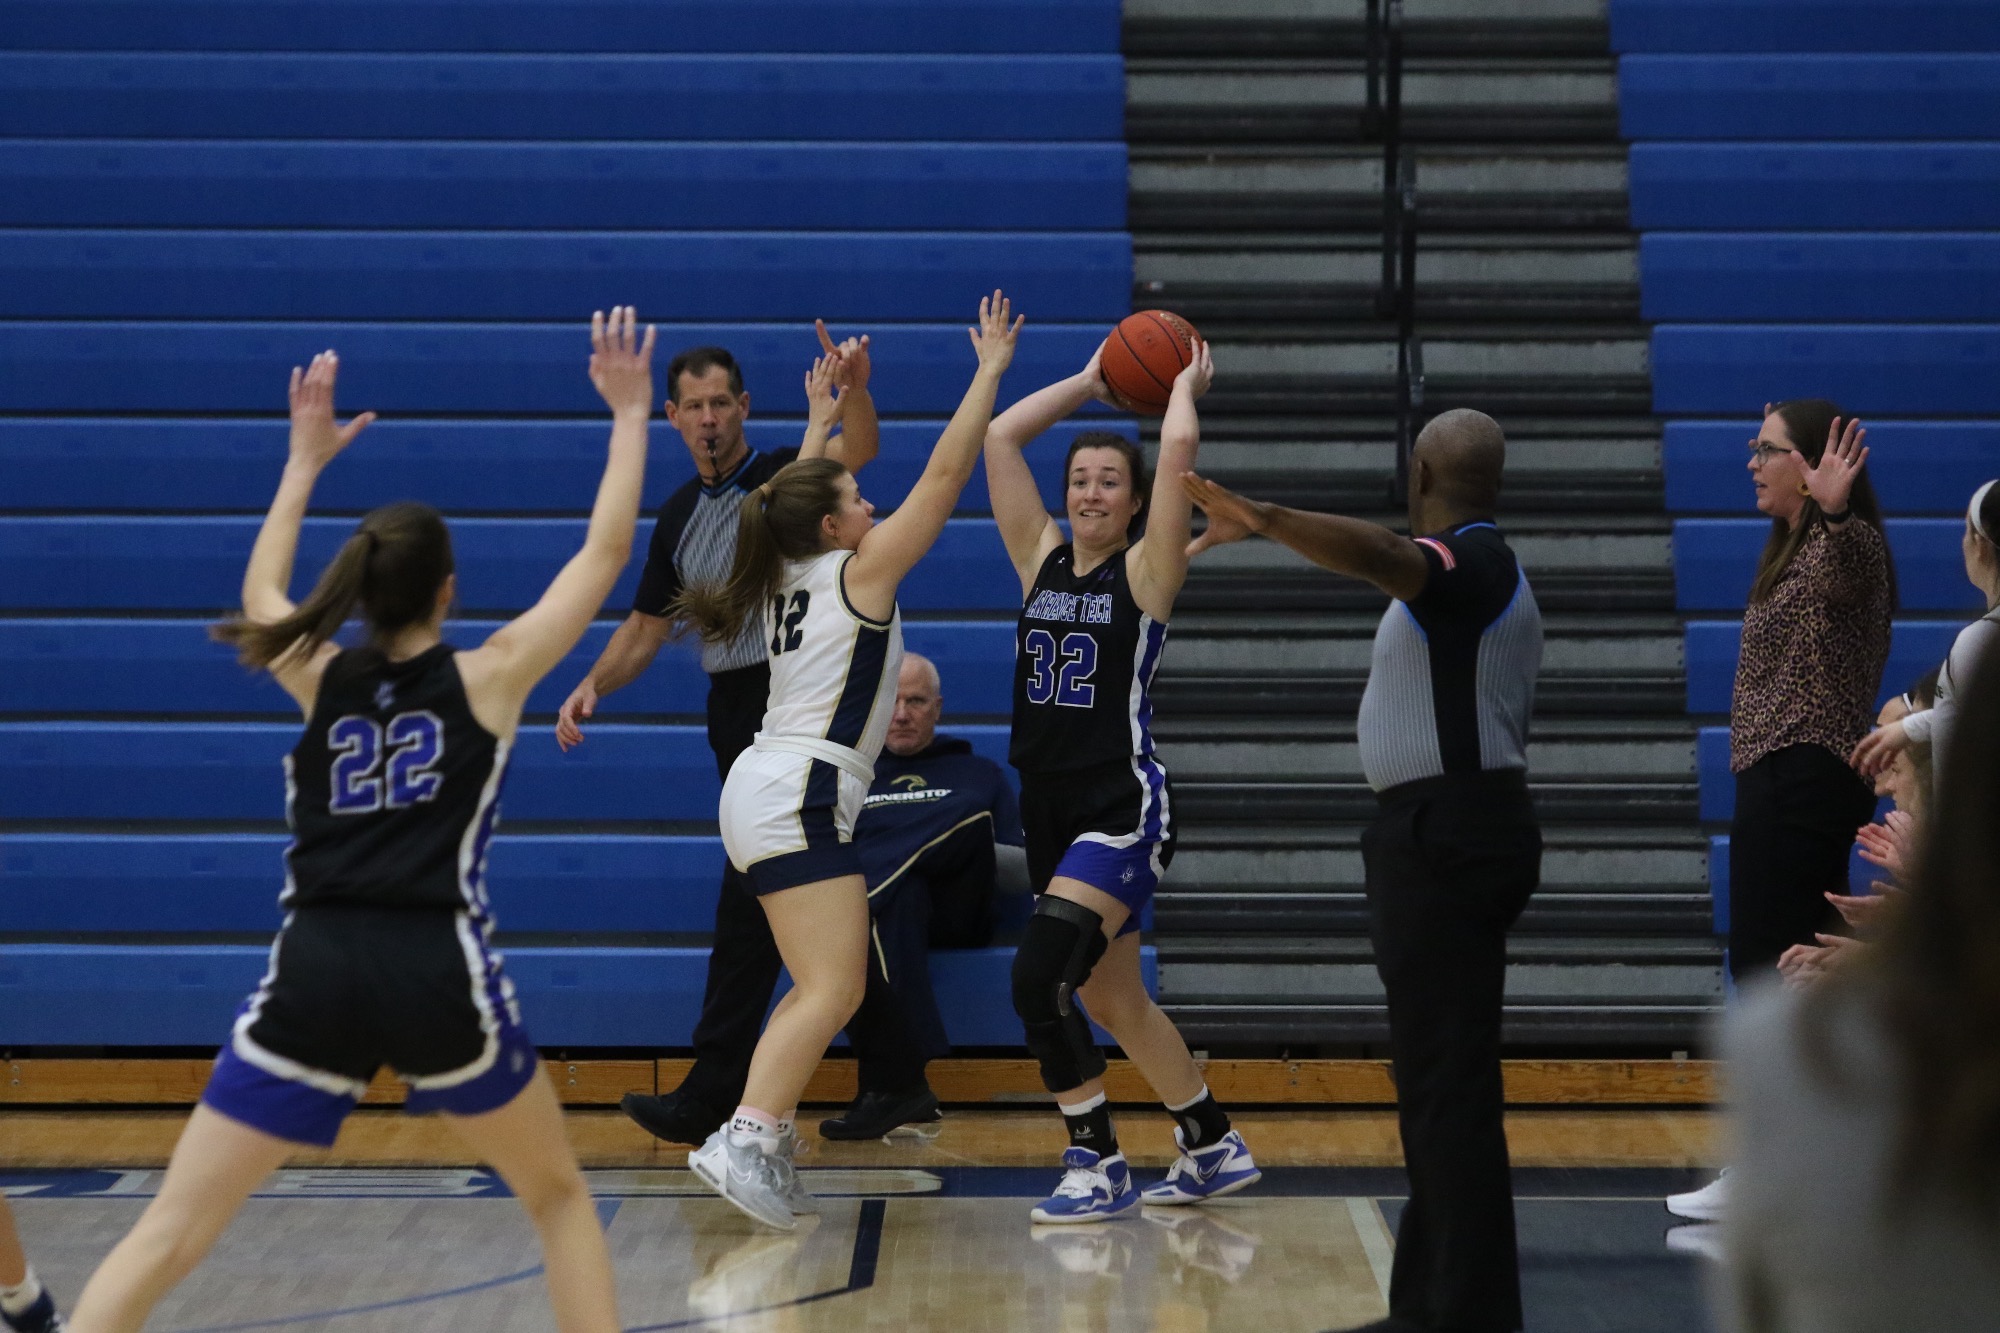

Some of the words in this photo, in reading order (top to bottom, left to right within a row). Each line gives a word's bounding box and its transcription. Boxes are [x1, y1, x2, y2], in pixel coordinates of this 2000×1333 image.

[771, 588, 810, 656] 12
[1080, 592, 1112, 624] TECH
[1025, 628, 1098, 708] 32
[328, 709, 444, 815] 22
[735, 1117, 763, 1132] NIKE
